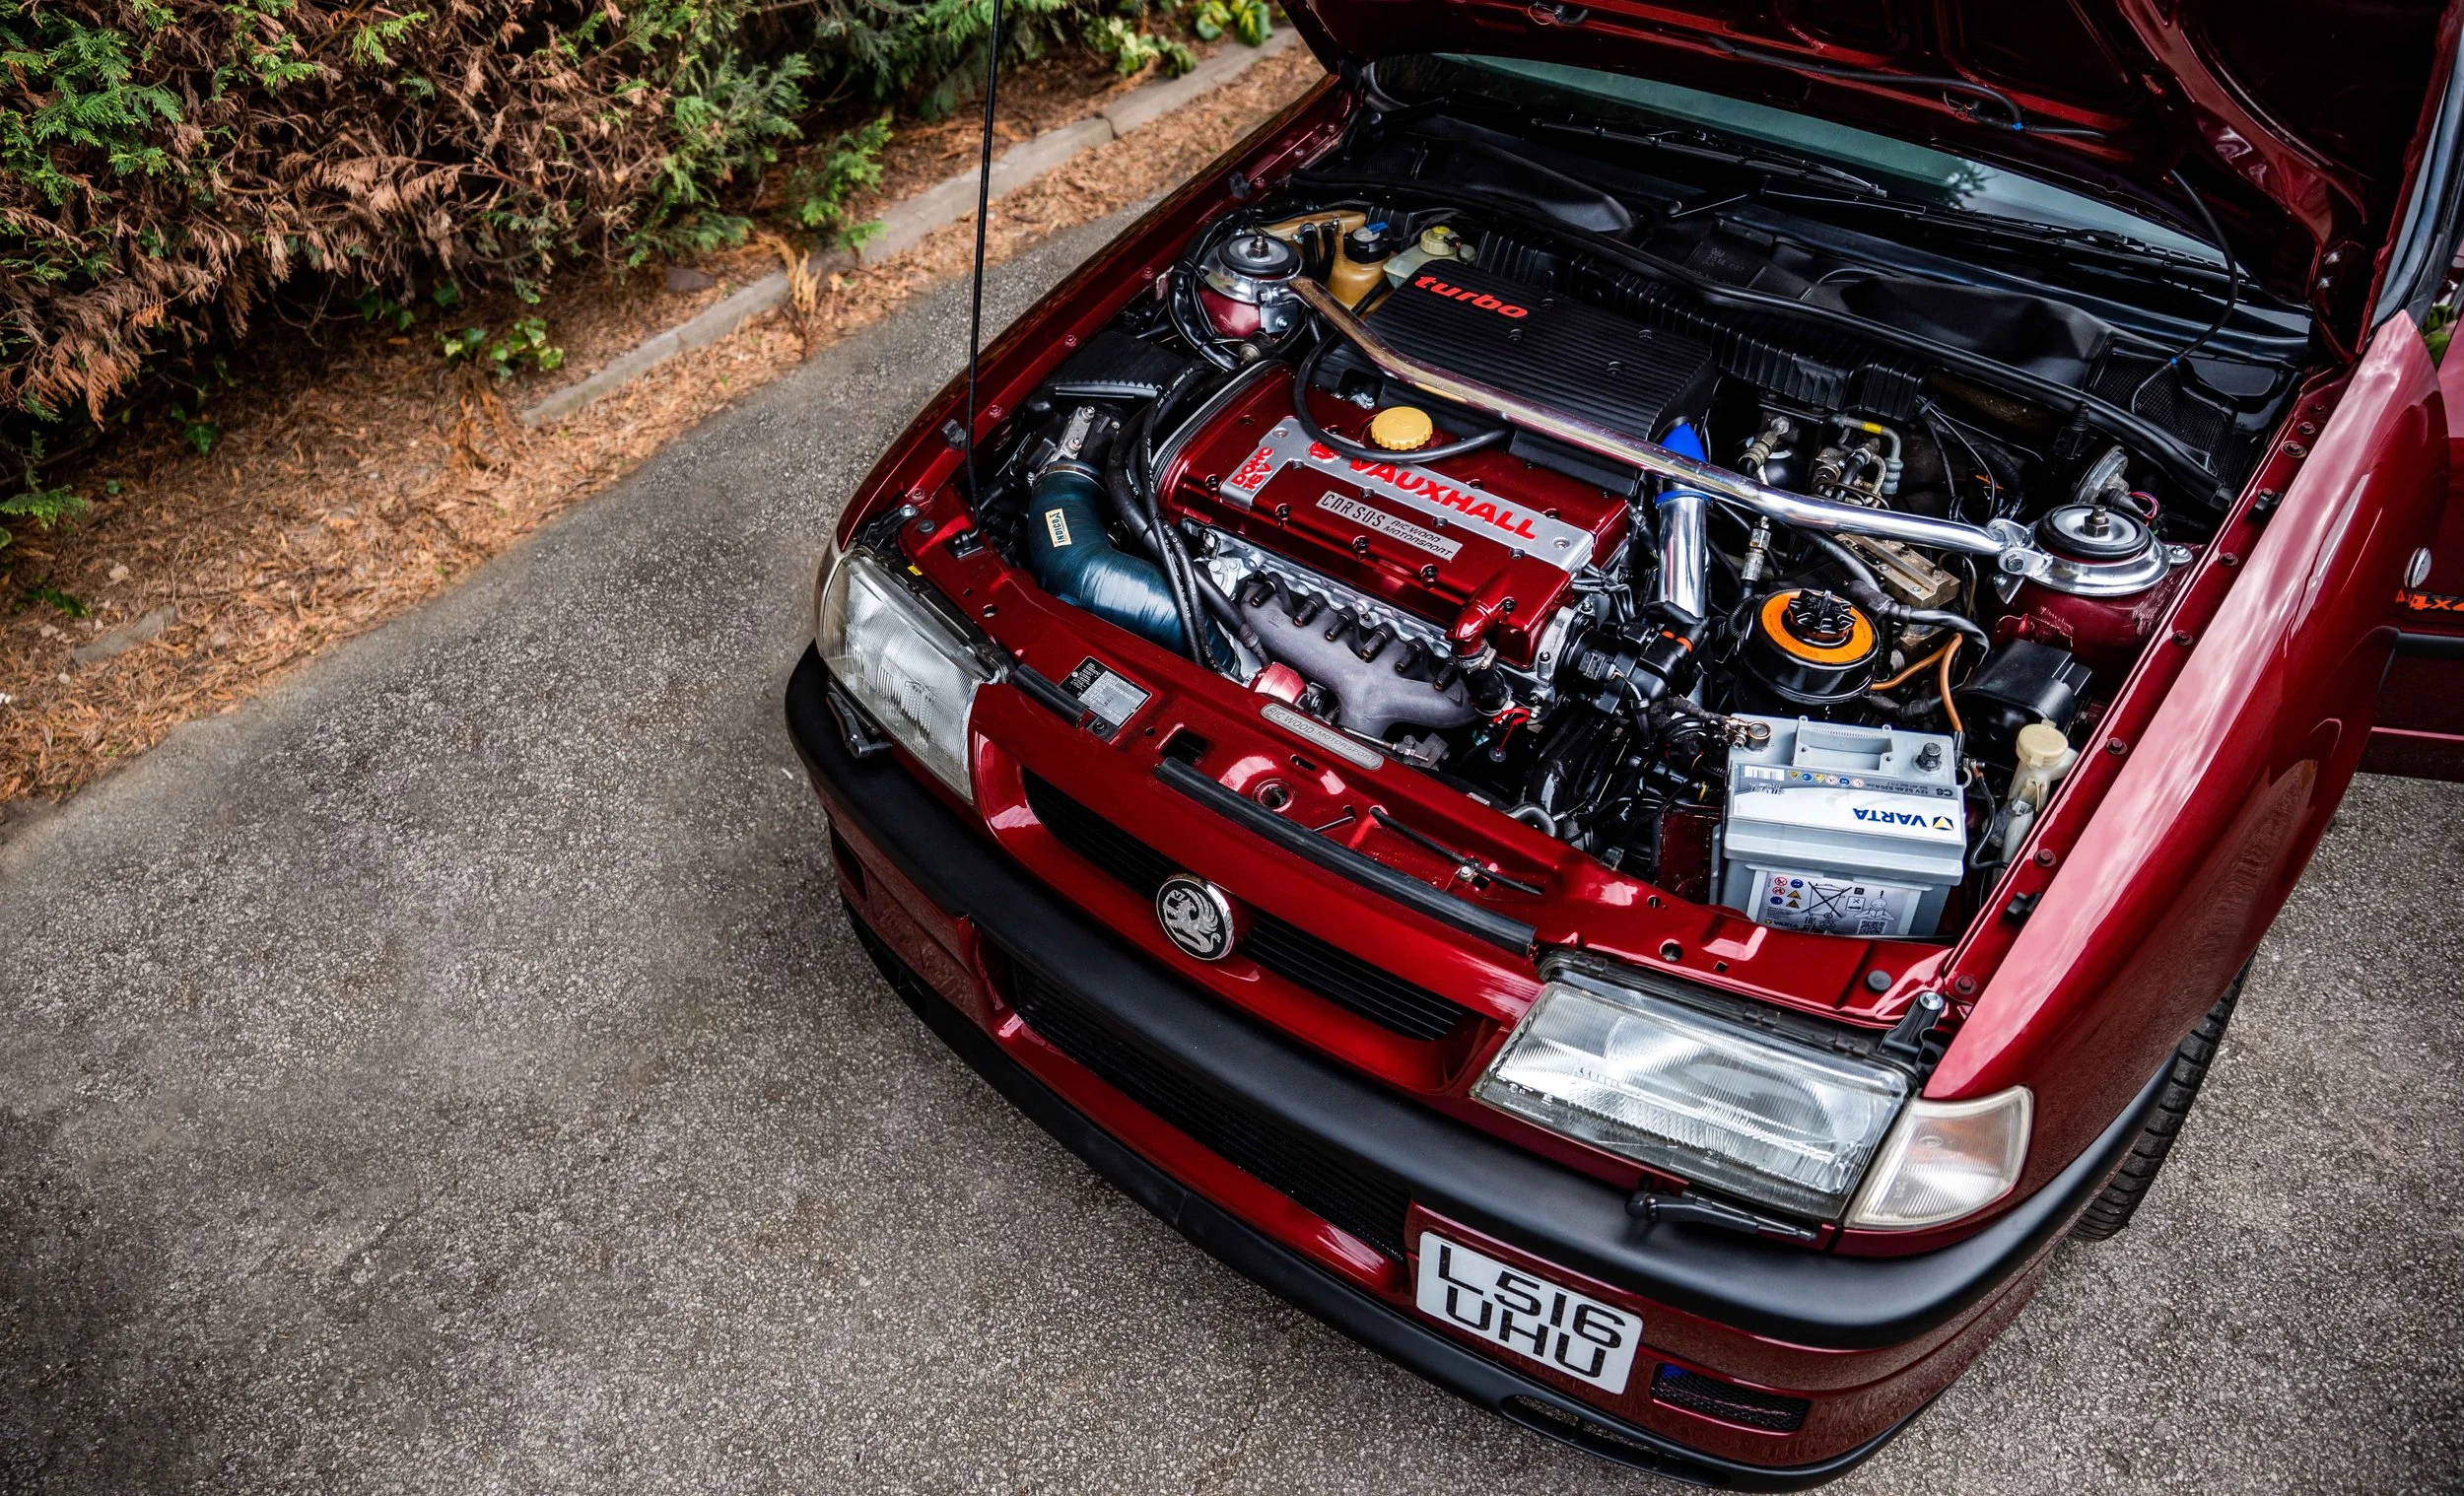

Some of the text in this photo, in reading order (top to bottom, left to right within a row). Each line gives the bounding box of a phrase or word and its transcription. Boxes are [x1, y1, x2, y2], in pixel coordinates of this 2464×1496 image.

[1413, 275, 1529, 318] turbo
[1230, 446, 1273, 487] DOHC
[1242, 462, 1272, 491] 16V
[1320, 493, 1354, 515] CAR
[1349, 457, 1538, 541] VAUXHALL
[1383, 525, 1454, 557] MOTORSPORT
[1391, 519, 1442, 543] RIC WOOD
[1266, 707, 1316, 735] RIC WOOD
[1317, 729, 1379, 763] MOTORSPORT
[1852, 807, 1928, 828] VARTA
[1774, 919, 1799, 928] VARTA
[1438, 1244, 1626, 1349] L516
[1445, 1284, 1608, 1379] UHU
